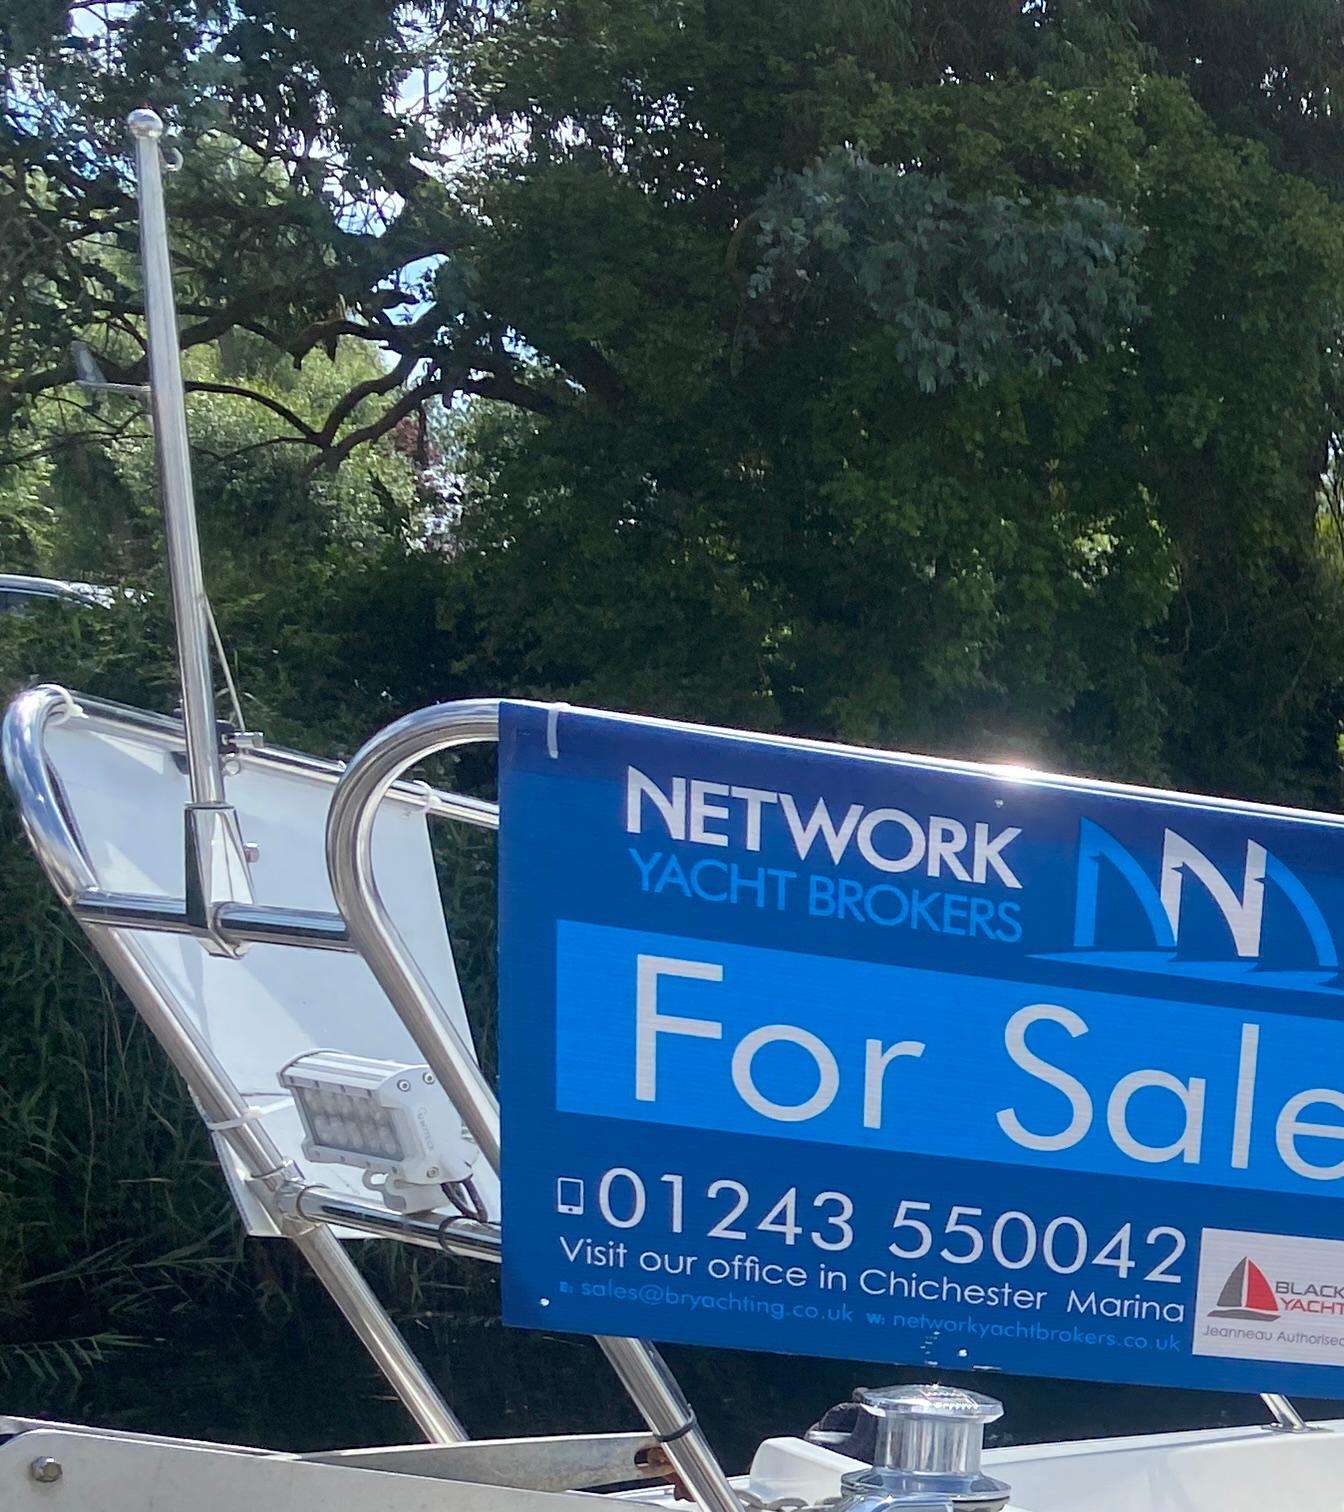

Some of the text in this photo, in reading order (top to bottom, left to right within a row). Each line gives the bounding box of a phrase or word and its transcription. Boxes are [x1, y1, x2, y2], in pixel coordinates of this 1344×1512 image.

[626, 765, 1023, 889] NETWORK
[628, 847, 1023, 942] YACHT BROKERS
[634, 953, 926, 1129] For
[598, 1167, 1187, 1284] 01243 550042
[559, 1236, 1186, 1323] Visit our office in Chichester Marina
[893, 1313, 1182, 1352] networkyachtbrokers.couk
